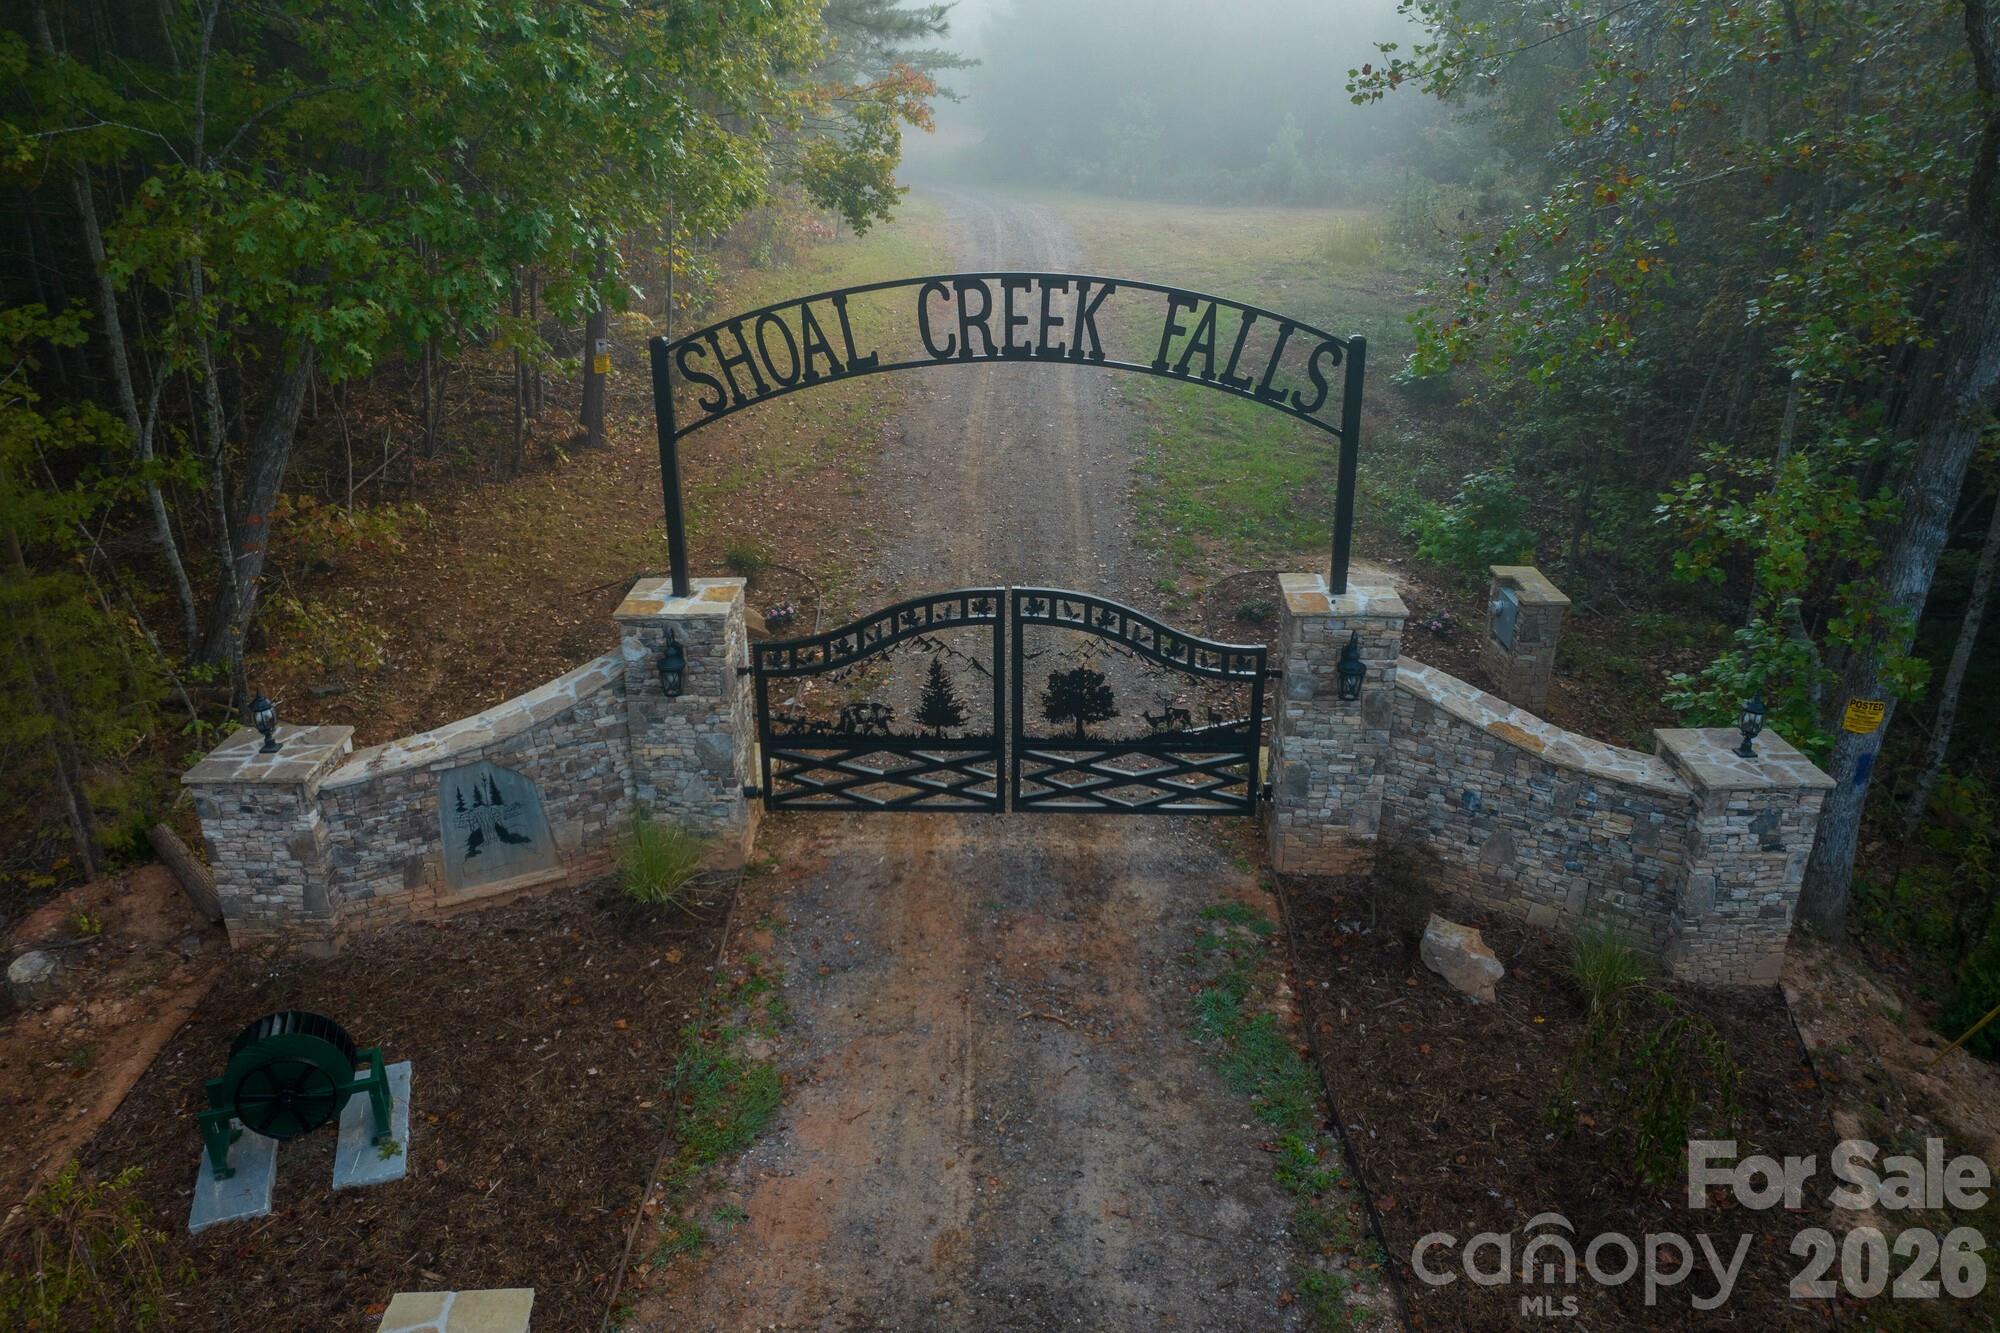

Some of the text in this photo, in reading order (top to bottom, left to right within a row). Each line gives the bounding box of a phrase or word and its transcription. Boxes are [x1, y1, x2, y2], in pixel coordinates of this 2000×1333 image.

[676, 279, 1343, 415] SHOAL CREEK FALLS
[1850, 699, 1884, 711] POSTED
